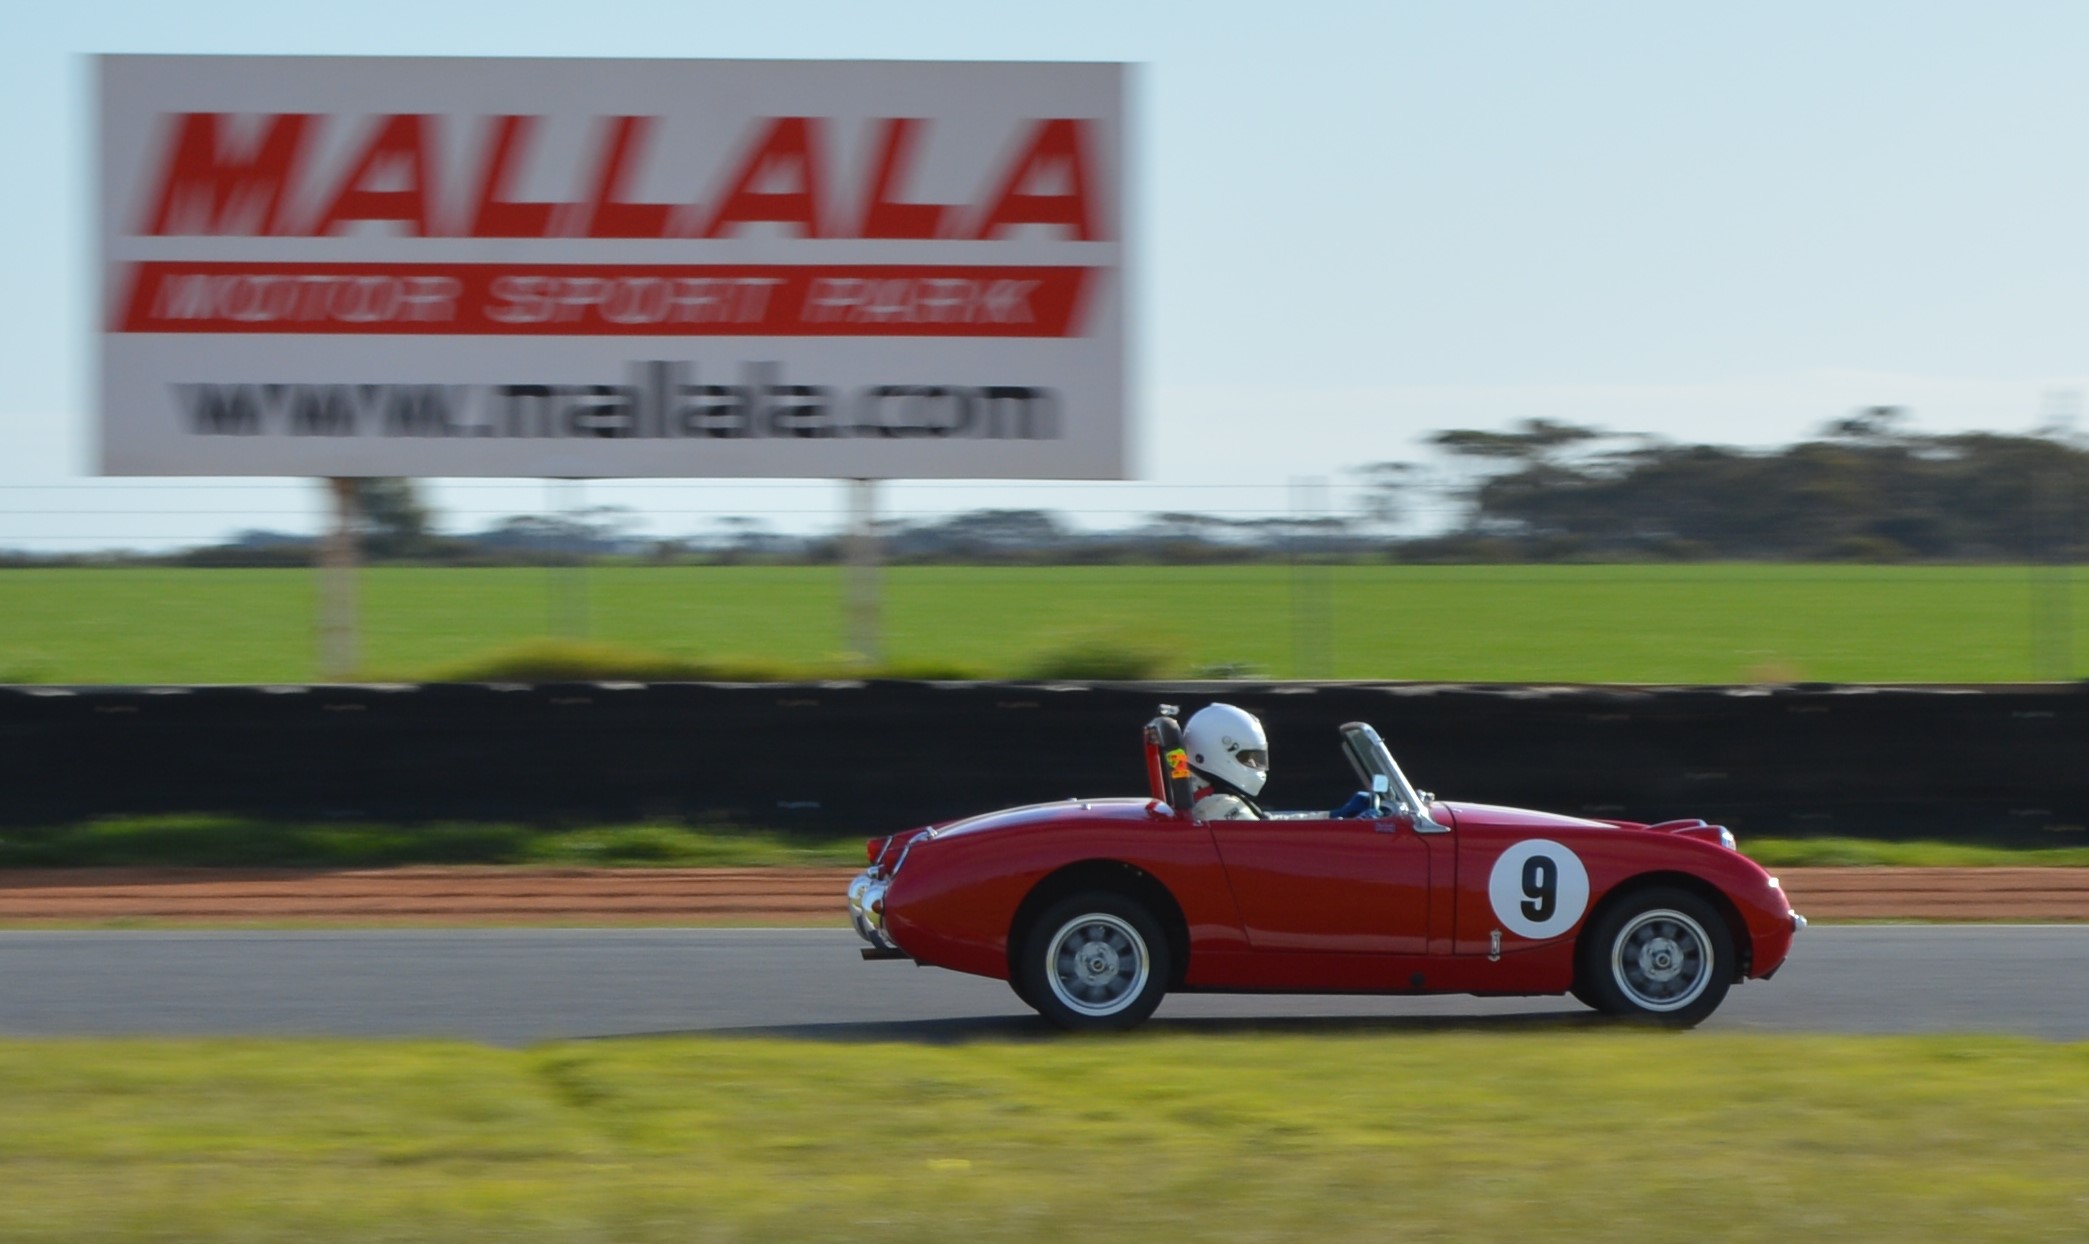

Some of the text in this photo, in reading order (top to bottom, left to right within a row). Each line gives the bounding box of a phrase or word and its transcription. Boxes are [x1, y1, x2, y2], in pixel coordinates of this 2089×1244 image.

[135, 112, 1112, 241] MALLALA
[150, 273, 1043, 324] MOTOR SPORT PARK
[166, 360, 1067, 440] www.mallala.com
[1520, 855, 1558, 922] 9
